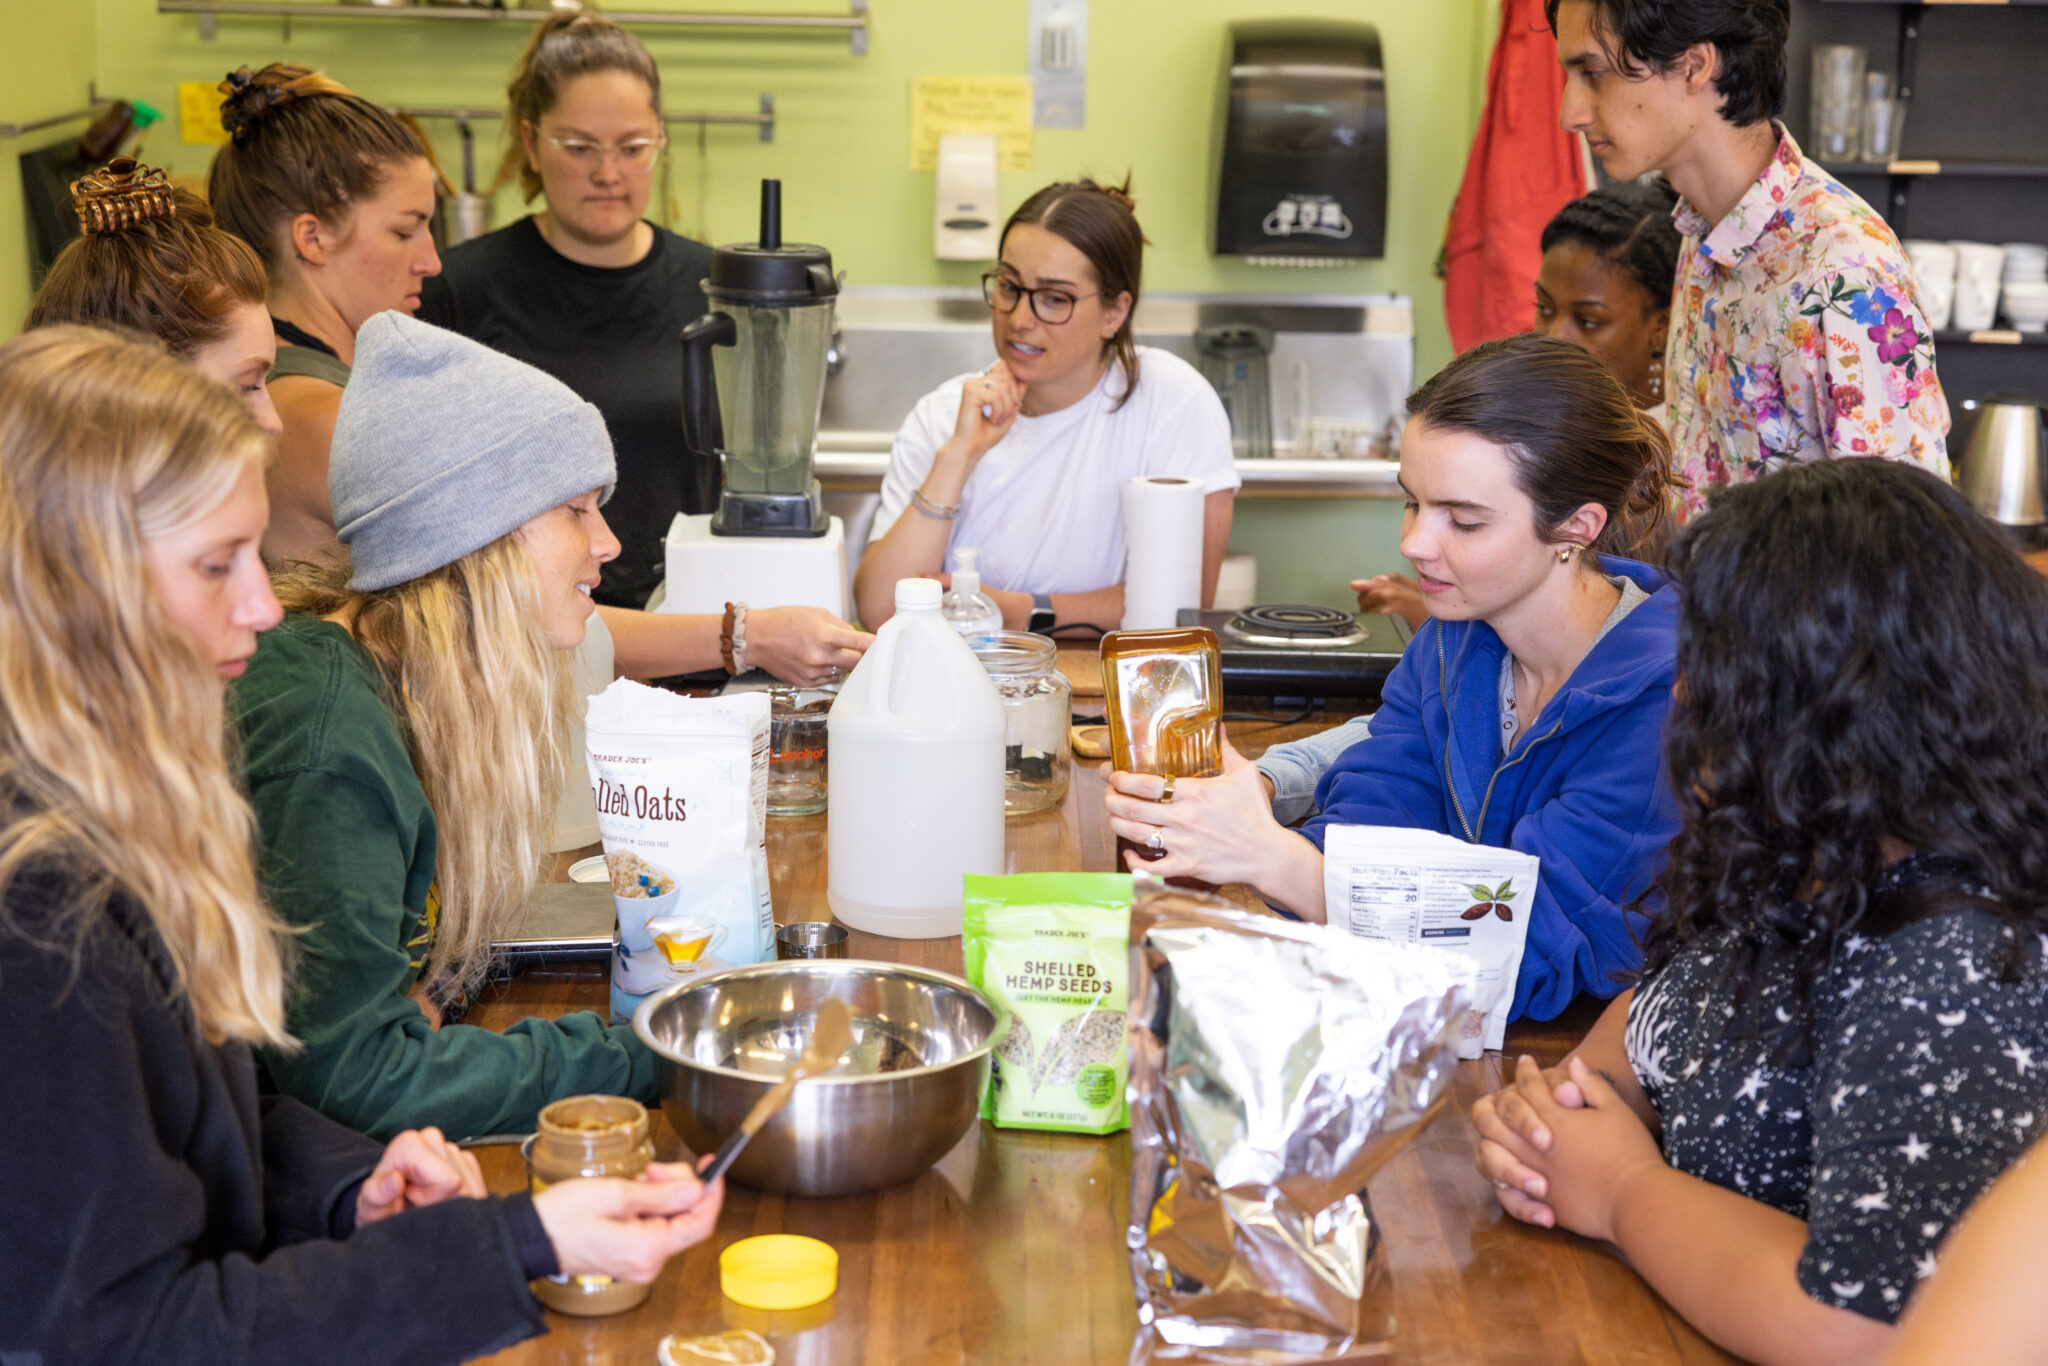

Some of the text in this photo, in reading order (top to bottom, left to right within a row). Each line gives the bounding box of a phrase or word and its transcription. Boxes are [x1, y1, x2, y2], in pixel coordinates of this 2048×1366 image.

[593, 754, 647, 765] TRADER JOE'S
[634, 785, 686, 821] Oats
[1405, 894, 1417, 902] 20
[1034, 929, 1064, 937] TRADER
[1024, 960, 1096, 978] SHELLED
[1006, 975, 1112, 994] HEMP SEEDS
